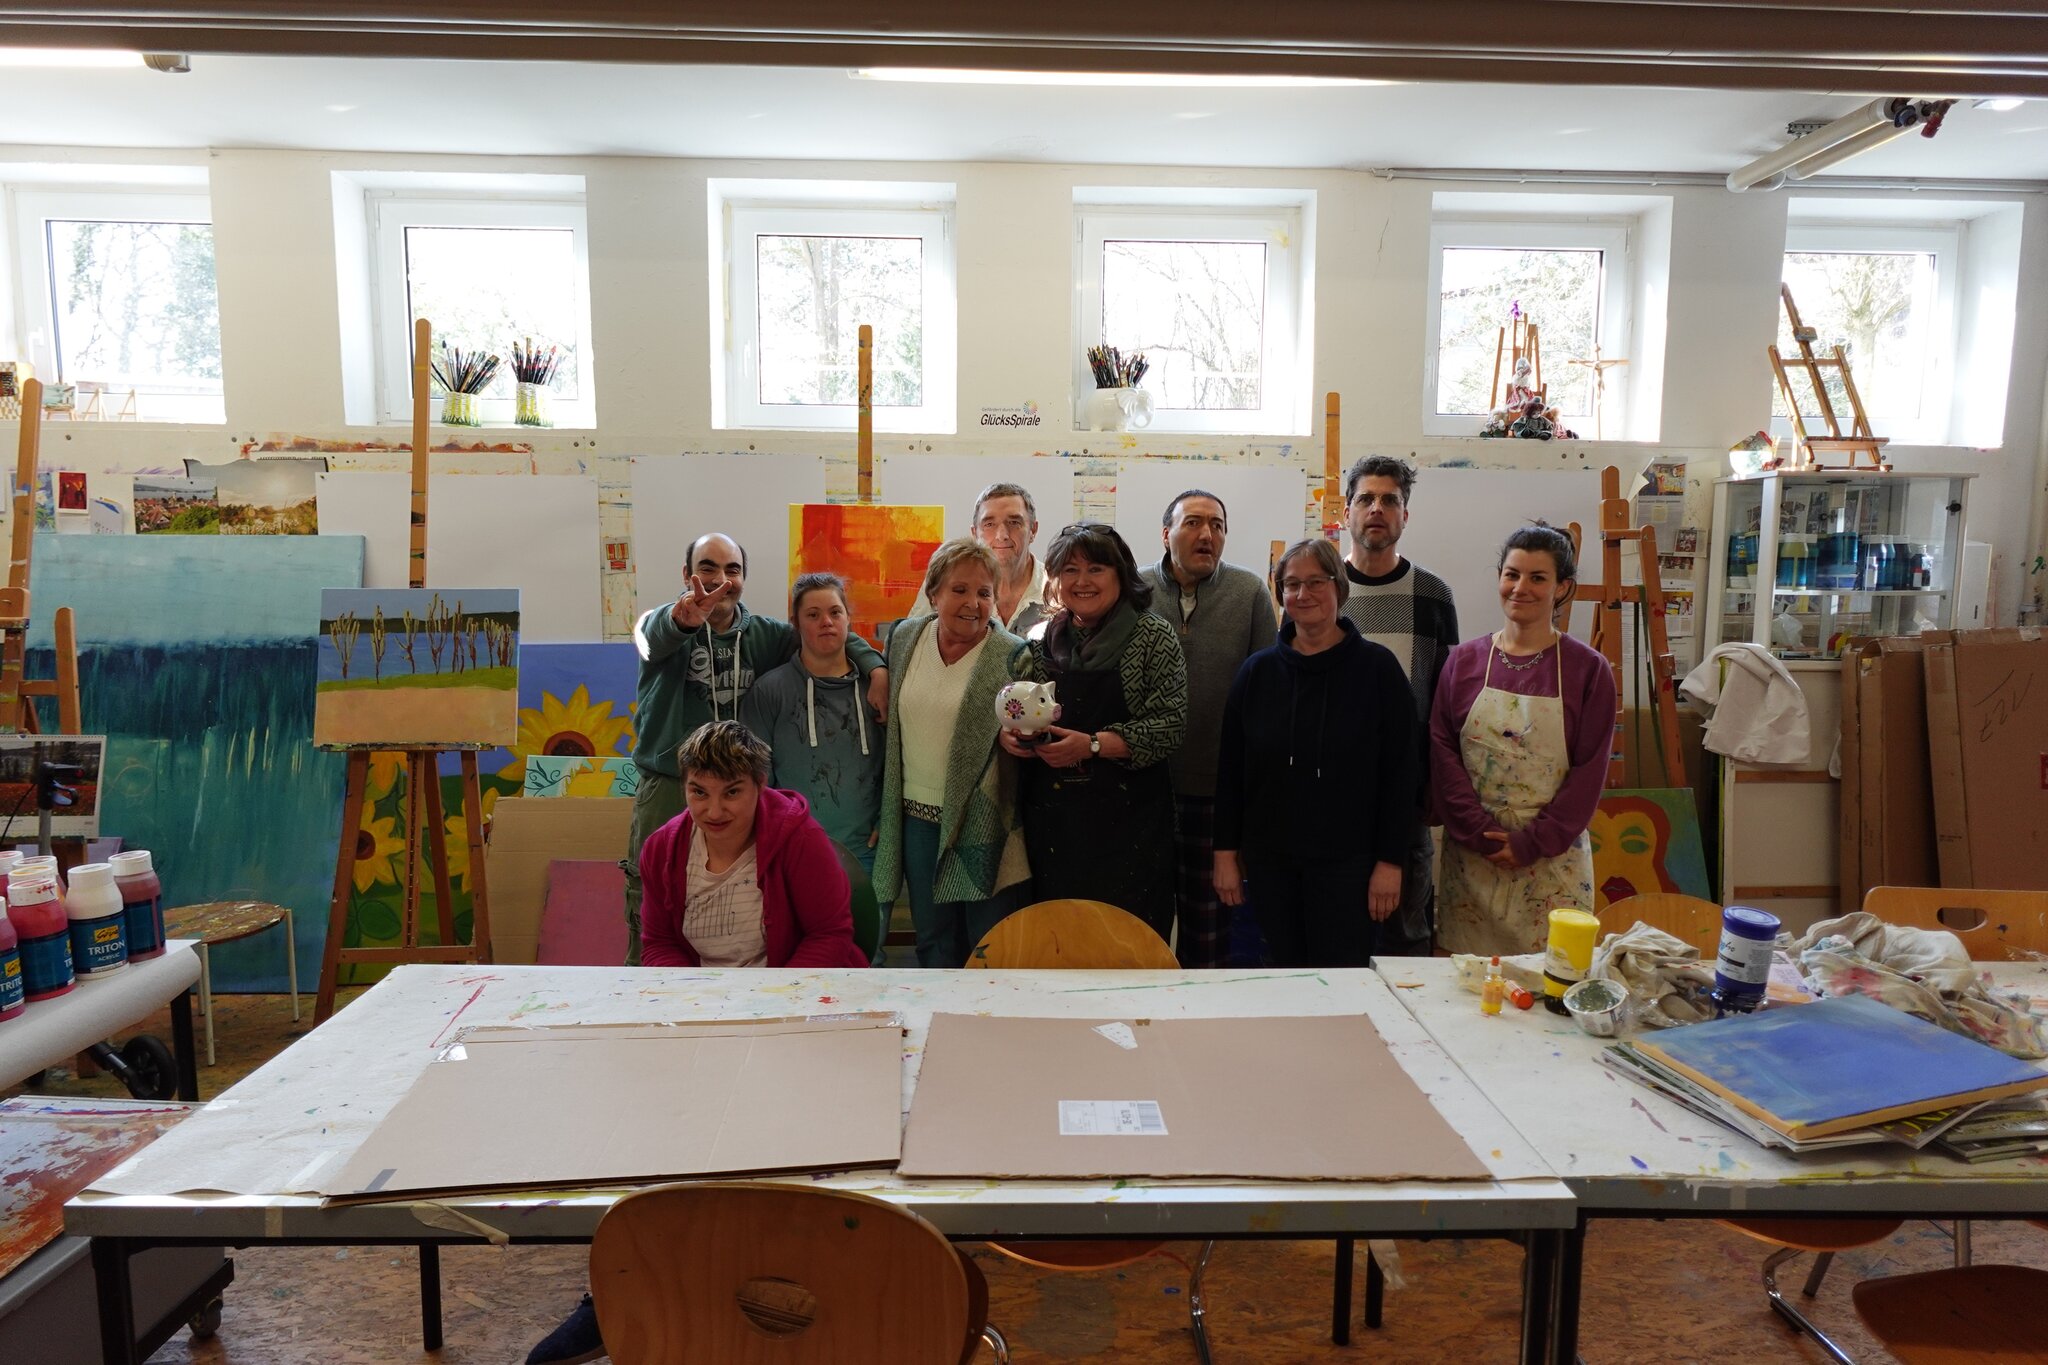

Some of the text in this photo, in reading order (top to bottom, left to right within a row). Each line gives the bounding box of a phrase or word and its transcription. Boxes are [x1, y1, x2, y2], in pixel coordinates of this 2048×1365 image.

[981, 413, 1041, 428] GlücksSpirale
[88, 940, 126, 956] TRITON
[97, 952, 121, 962] ACRYLIC
